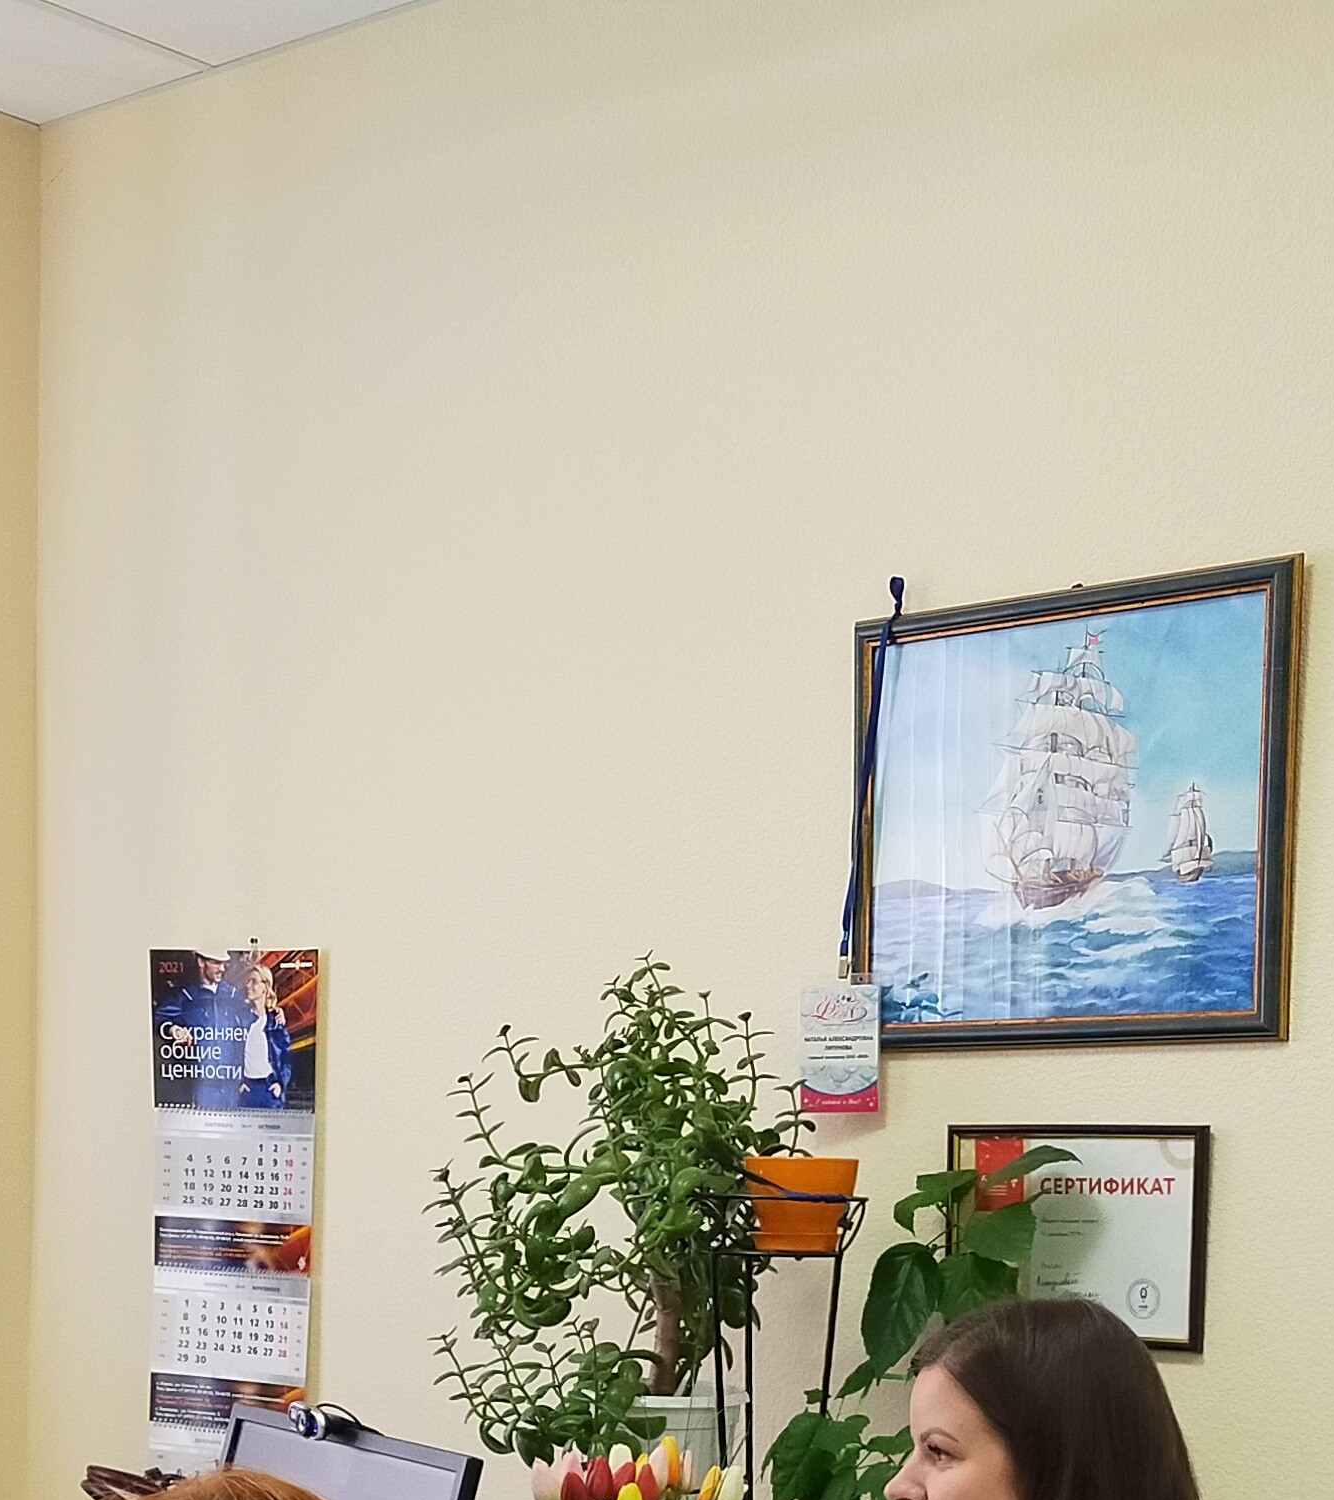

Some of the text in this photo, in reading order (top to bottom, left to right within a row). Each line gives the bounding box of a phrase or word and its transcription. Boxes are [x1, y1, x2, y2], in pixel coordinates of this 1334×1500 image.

[159, 962, 184, 973] 2021
[160, 1040, 222, 1062] общие
[161, 1063, 242, 1080] ценности
[259, 1144, 263, 1152] 1
[273, 1144, 278, 1153] 2
[187, 1154, 293, 1167] 4 5 6 7 8 9 10
[184, 1168, 293, 1181] 11 12 13 14 15 16 17
[184, 1182, 195, 1190] 18
[203, 1183, 214, 1191] 19
[221, 1184, 232, 1192] 20
[237, 1185, 248, 1193] 21
[254, 1186, 264, 1194] 22
[269, 1187, 279, 1195] 23
[1040, 1177, 1176, 1195] СЕРТИФИКАТ
[183, 1195, 291, 1210] 25 26 27 28 29 30 31
[185, 1299, 189, 1307] 1
[202, 1300, 207, 1308] 2
[220, 1302, 225, 1310] 3
[236, 1303, 241, 1311] 4
[253, 1304, 257, 1313] 5
[267, 1306, 273, 1314] 6
[183, 1312, 188, 1320] 8
[201, 1314, 207, 1322] 9
[217, 1316, 227, 1324] 10
[234, 1317, 243, 1326] 11
[250, 1319, 259, 1327] 12
[266, 1320, 274, 1329] 13
[180, 1326, 287, 1344] 15 16 17 18 19 20 21
[178, 1340, 287, 1357] 22 23 24 25 26 27 28
[177, 1353, 207, 1364] 29 30
